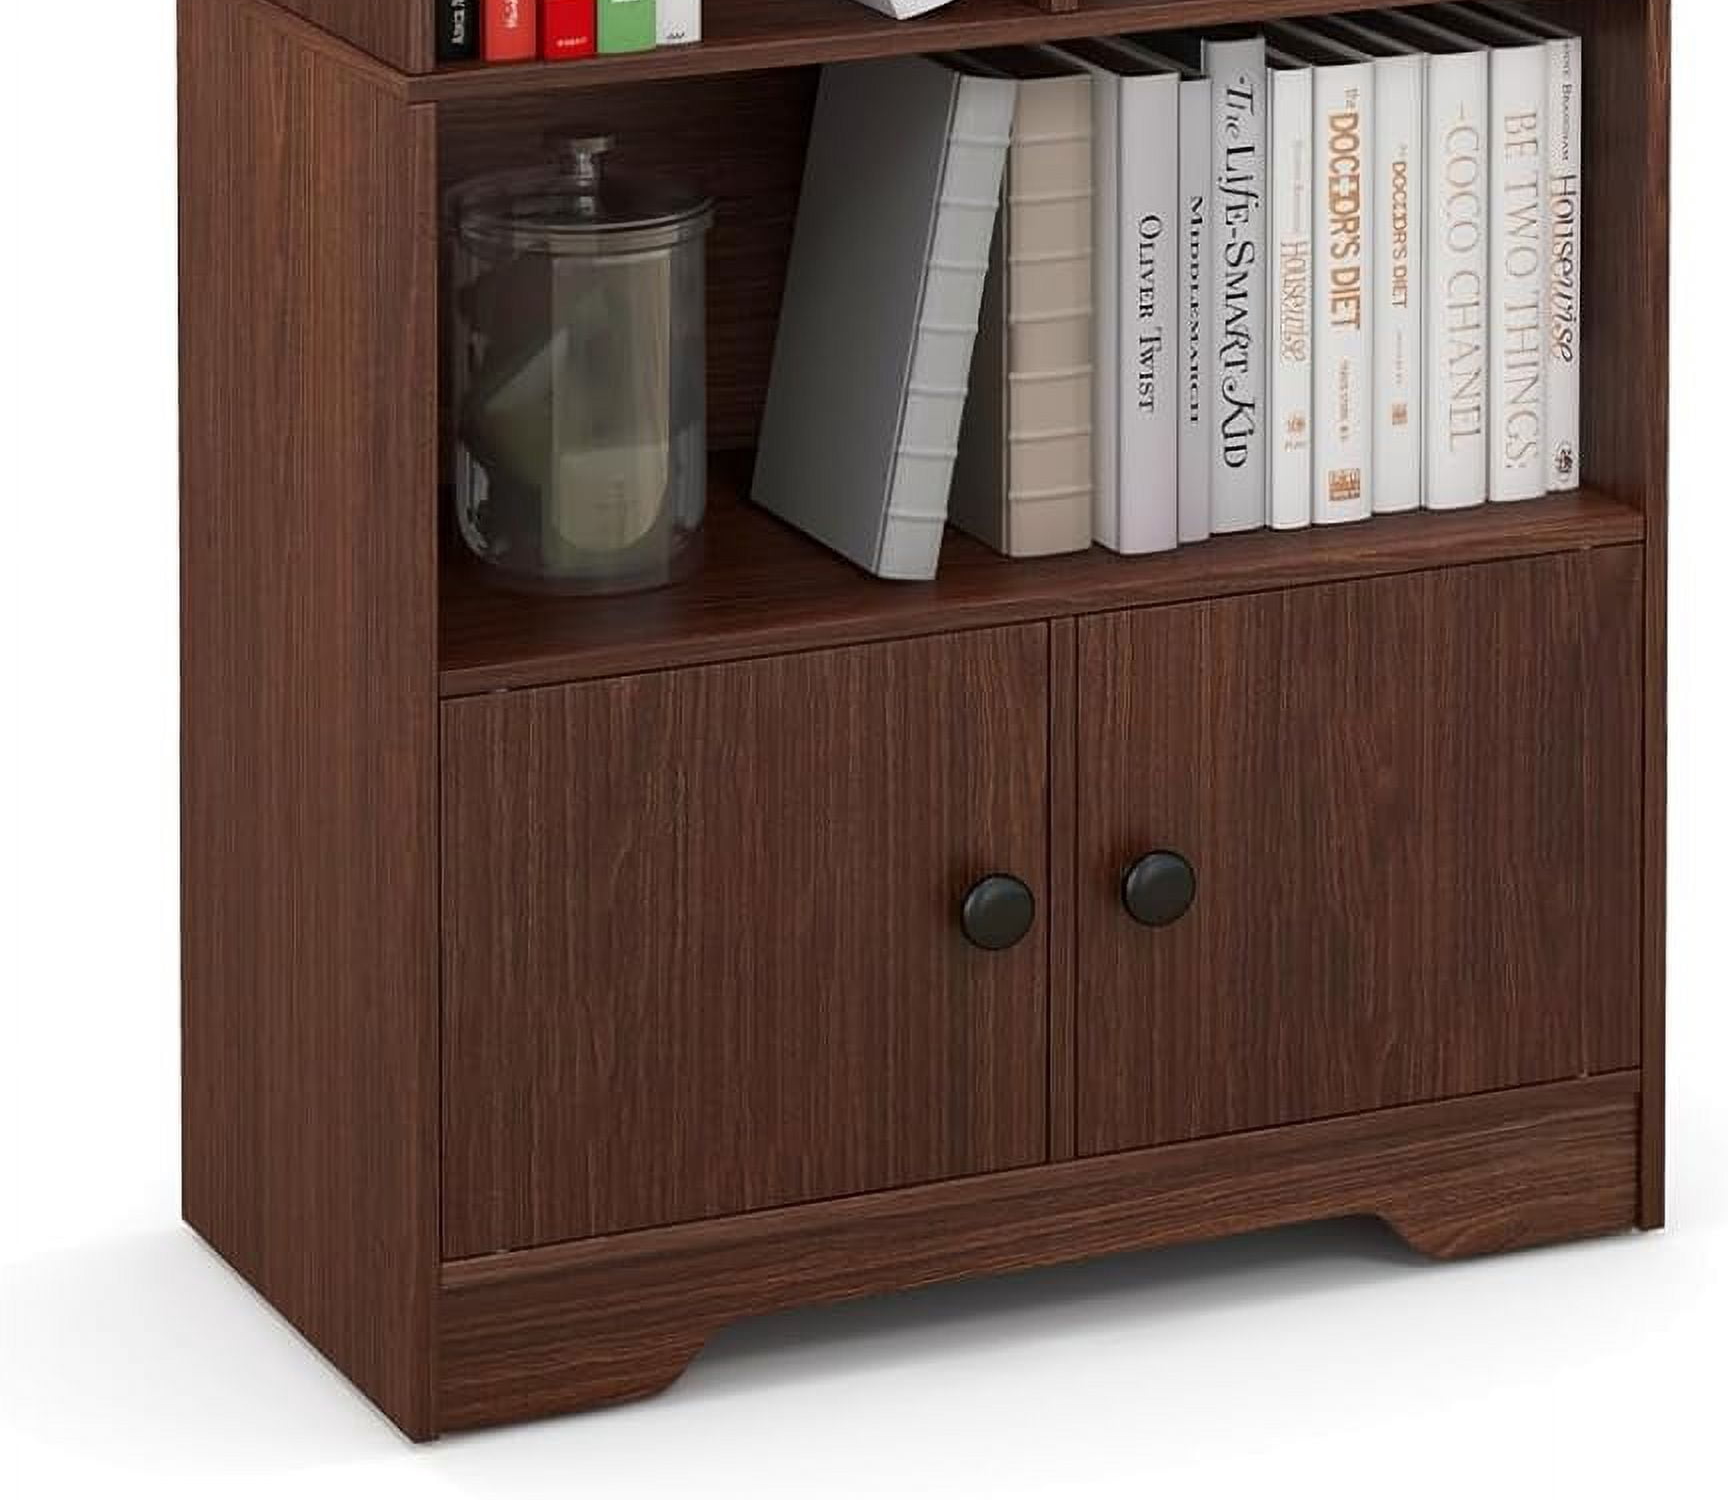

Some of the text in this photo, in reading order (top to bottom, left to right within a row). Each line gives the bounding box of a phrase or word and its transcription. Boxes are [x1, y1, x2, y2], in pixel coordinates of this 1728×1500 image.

[1225, 84, 1257, 141] The
[1504, 111, 1539, 160] BE
[1504, 172, 1539, 278] TWO
[1329, 267, 1362, 331] DIET
[1391, 266, 1409, 308] DIET
[1549, 173, 1578, 363] Housewise
[1446, 269, 1481, 454] CHANEL
